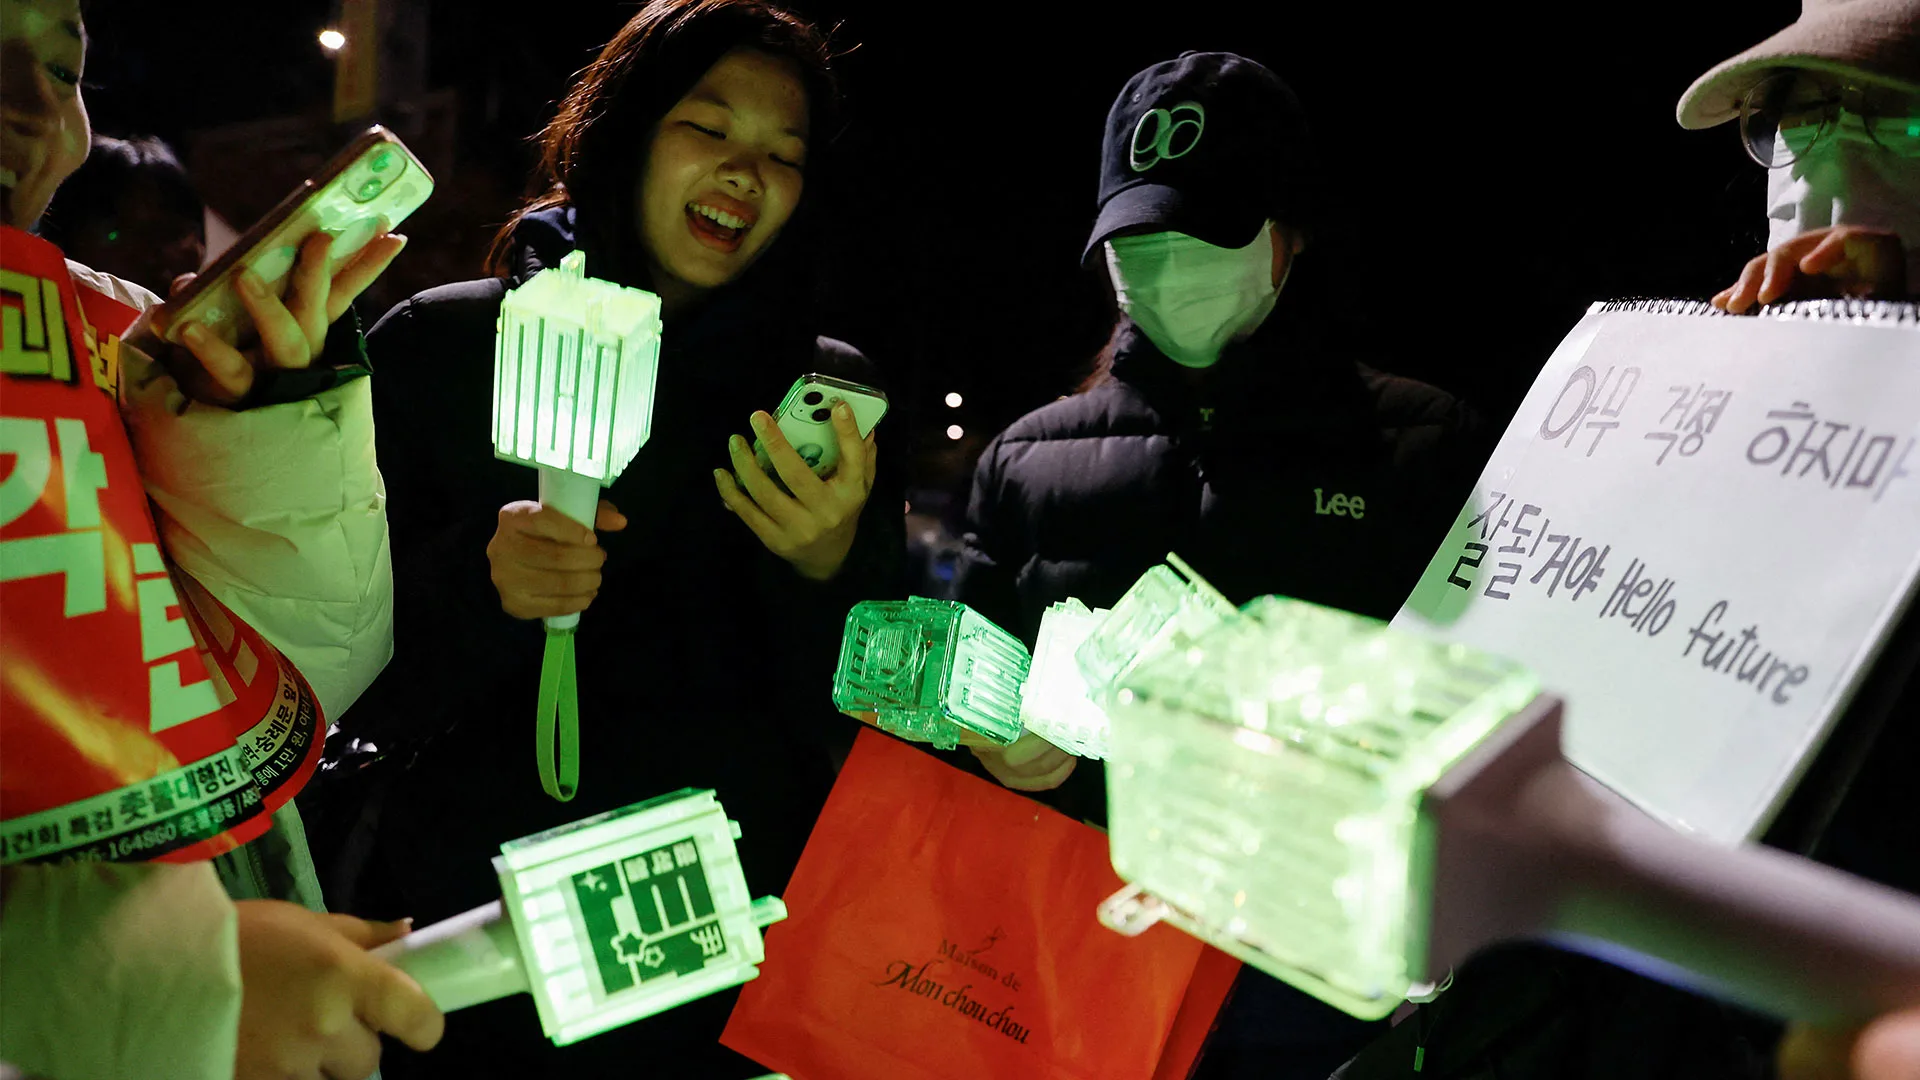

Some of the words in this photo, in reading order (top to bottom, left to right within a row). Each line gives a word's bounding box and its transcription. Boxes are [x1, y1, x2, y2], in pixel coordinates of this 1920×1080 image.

[1539, 365, 1642, 457] 아무
[1644, 383, 1732, 466] 걱정
[1314, 488, 1366, 519] Lee
[1599, 558, 1676, 637] Hello
[1683, 600, 1808, 706] future
[937, 939, 998, 981] Maison
[1002, 972, 1022, 992] de
